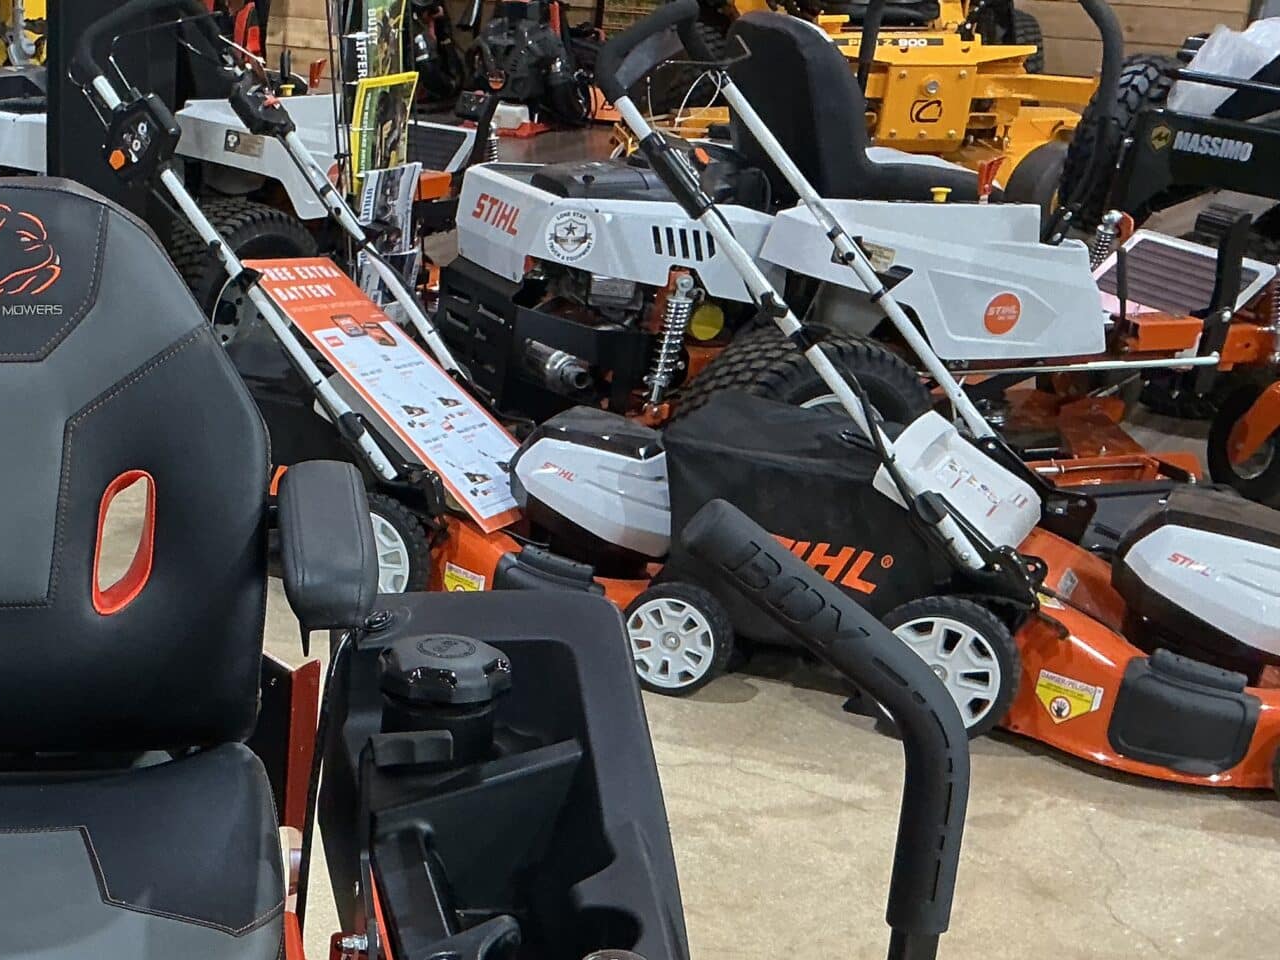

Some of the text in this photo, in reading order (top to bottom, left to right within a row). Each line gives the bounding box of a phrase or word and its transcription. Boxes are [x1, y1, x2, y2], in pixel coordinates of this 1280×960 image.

[898, 38, 928, 47] 900
[1172, 130, 1254, 162] MASSIMO
[472, 193, 518, 236] STIHL
[572, 212, 587, 220] STAR
[261, 265, 341, 282] FREE EXTRA
[273, 283, 337, 301] BATTERY
[2, 304, 63, 316] MOWERS
[988, 307, 1018, 316] STIHL
